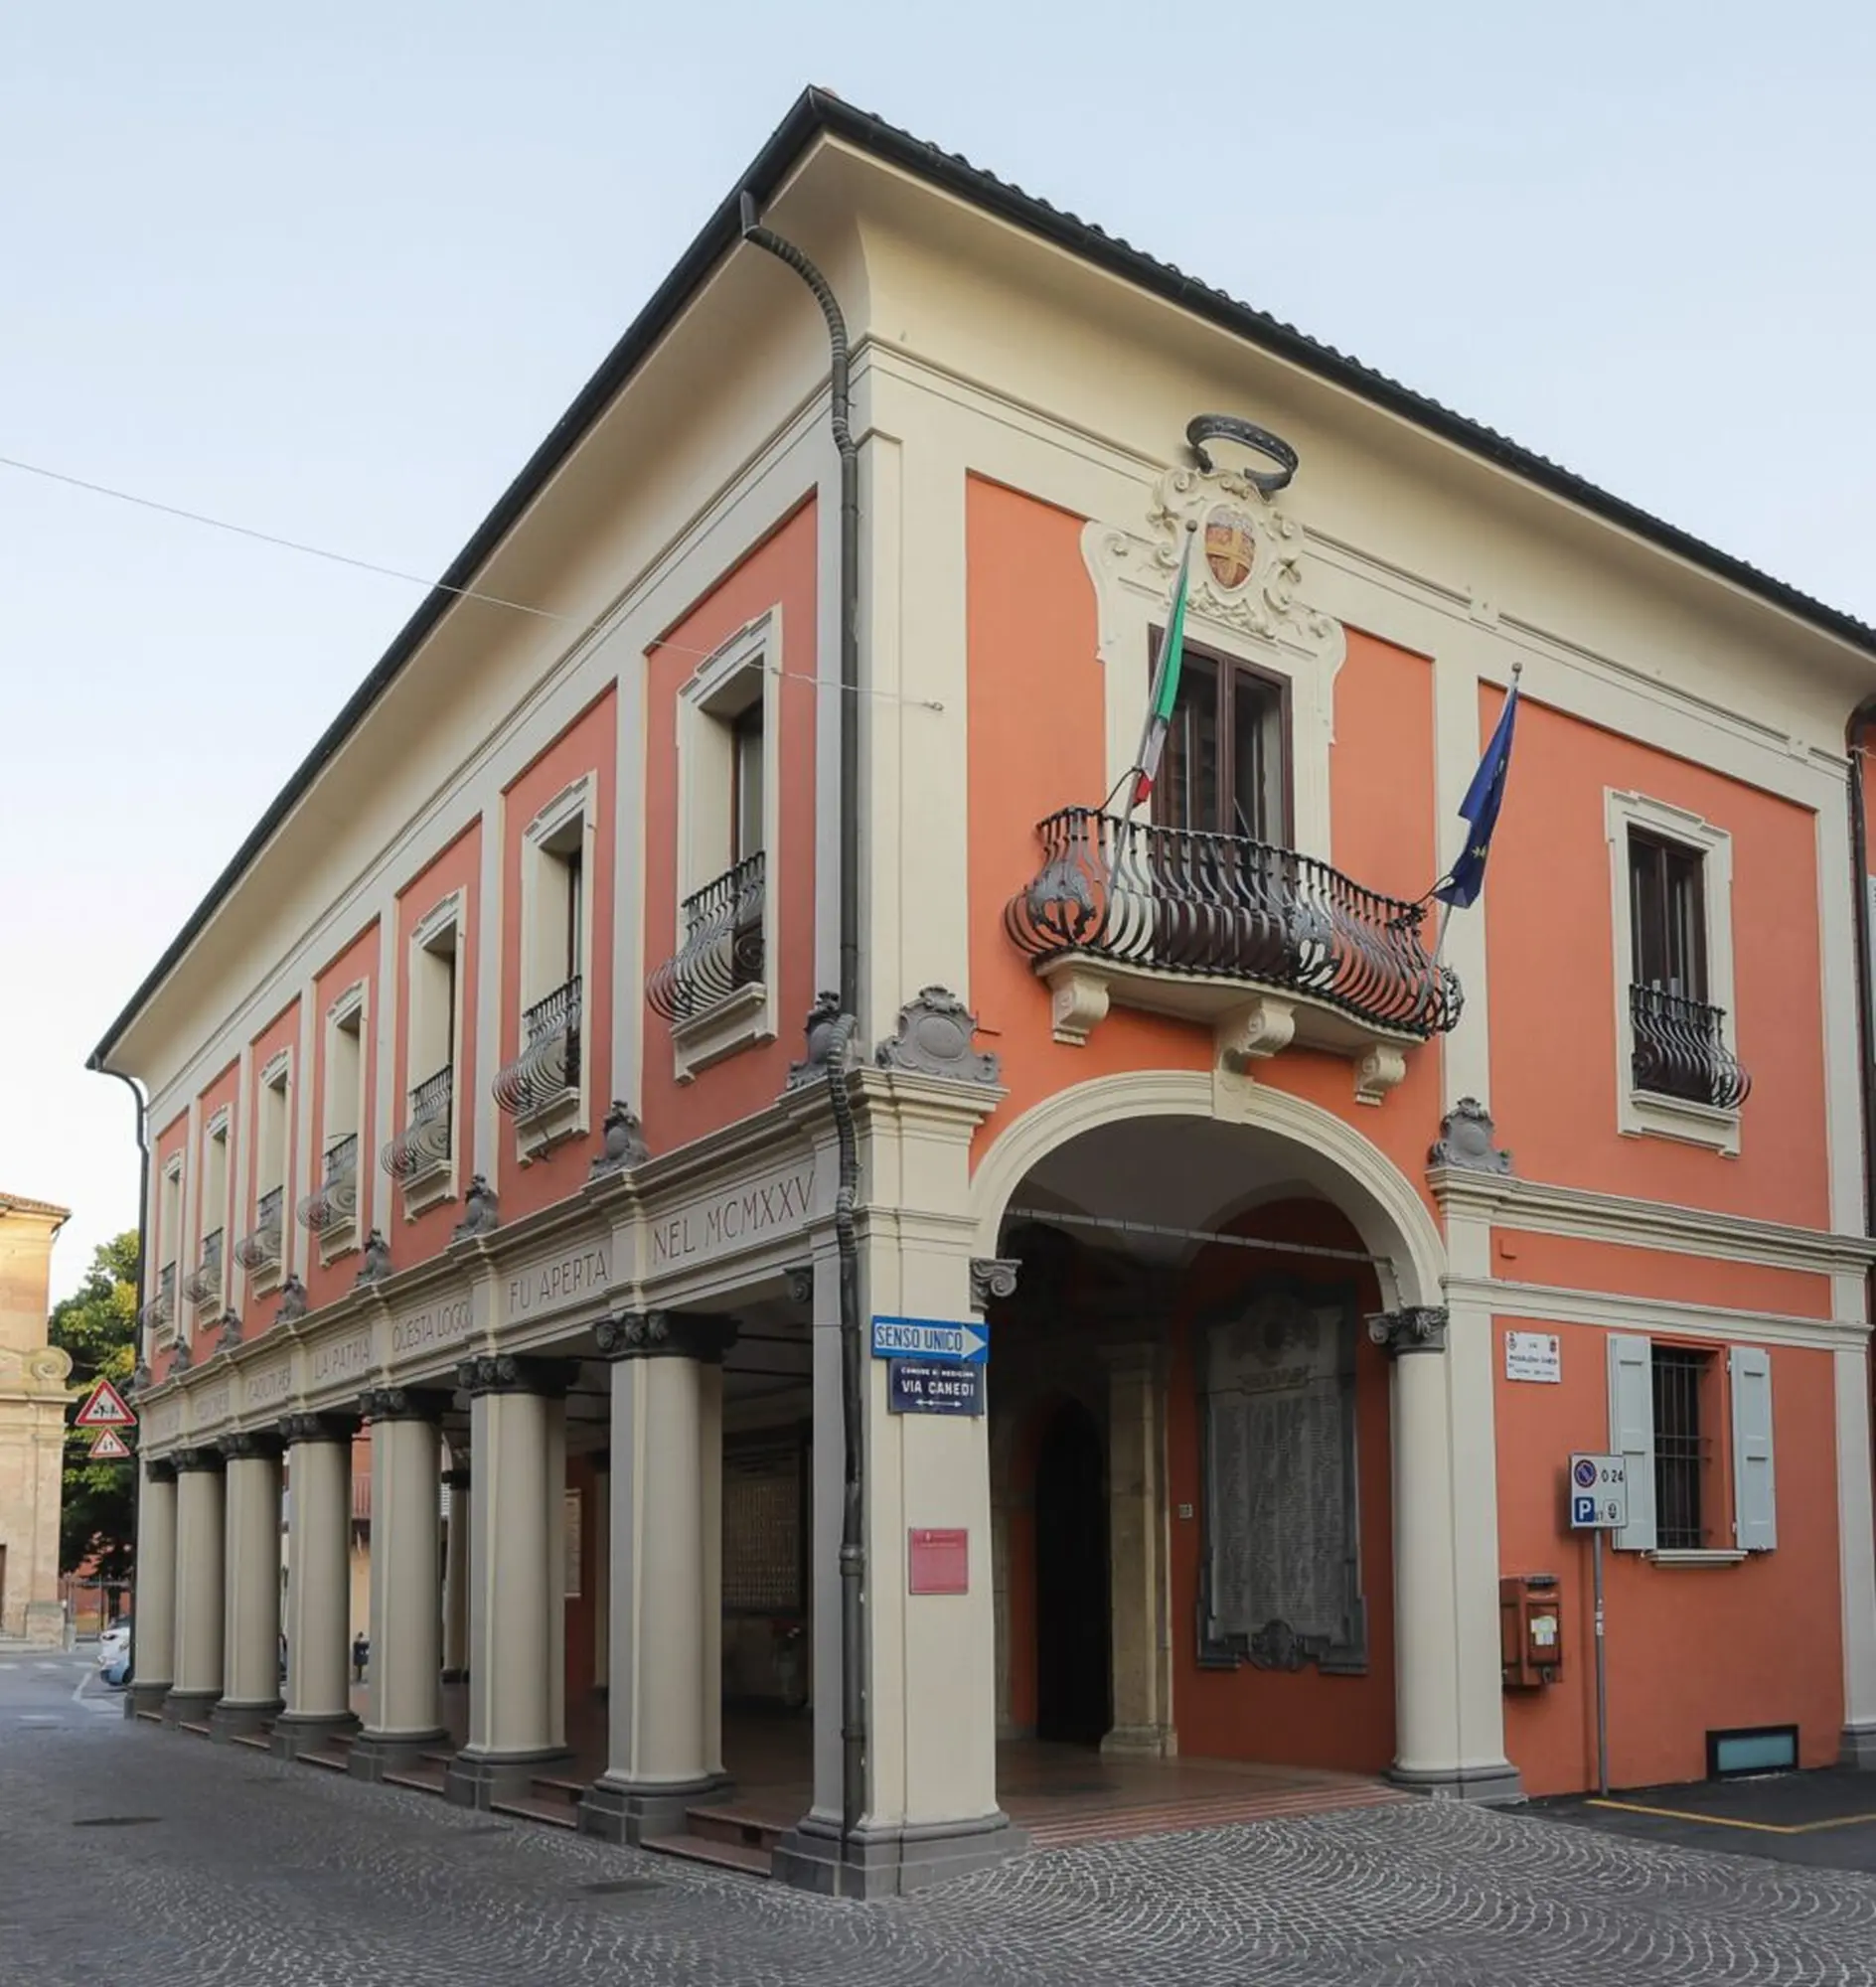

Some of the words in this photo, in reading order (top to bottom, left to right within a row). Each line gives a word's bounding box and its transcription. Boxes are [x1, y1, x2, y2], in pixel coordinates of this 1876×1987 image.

[654, 1217, 697, 1266] NEL
[705, 1169, 815, 1248] MCMXXV
[509, 1278, 532, 1314] FU
[539, 1249, 608, 1304] APERTA
[875, 1324, 921, 1349] SENSO
[924, 1328, 964, 1352] UNICO
[900, 1379, 923, 1394] VIA
[928, 1381, 975, 1397] CANEDI
[1611, 1469, 1625, 1483] 24
[1578, 1499, 1592, 1520] P
